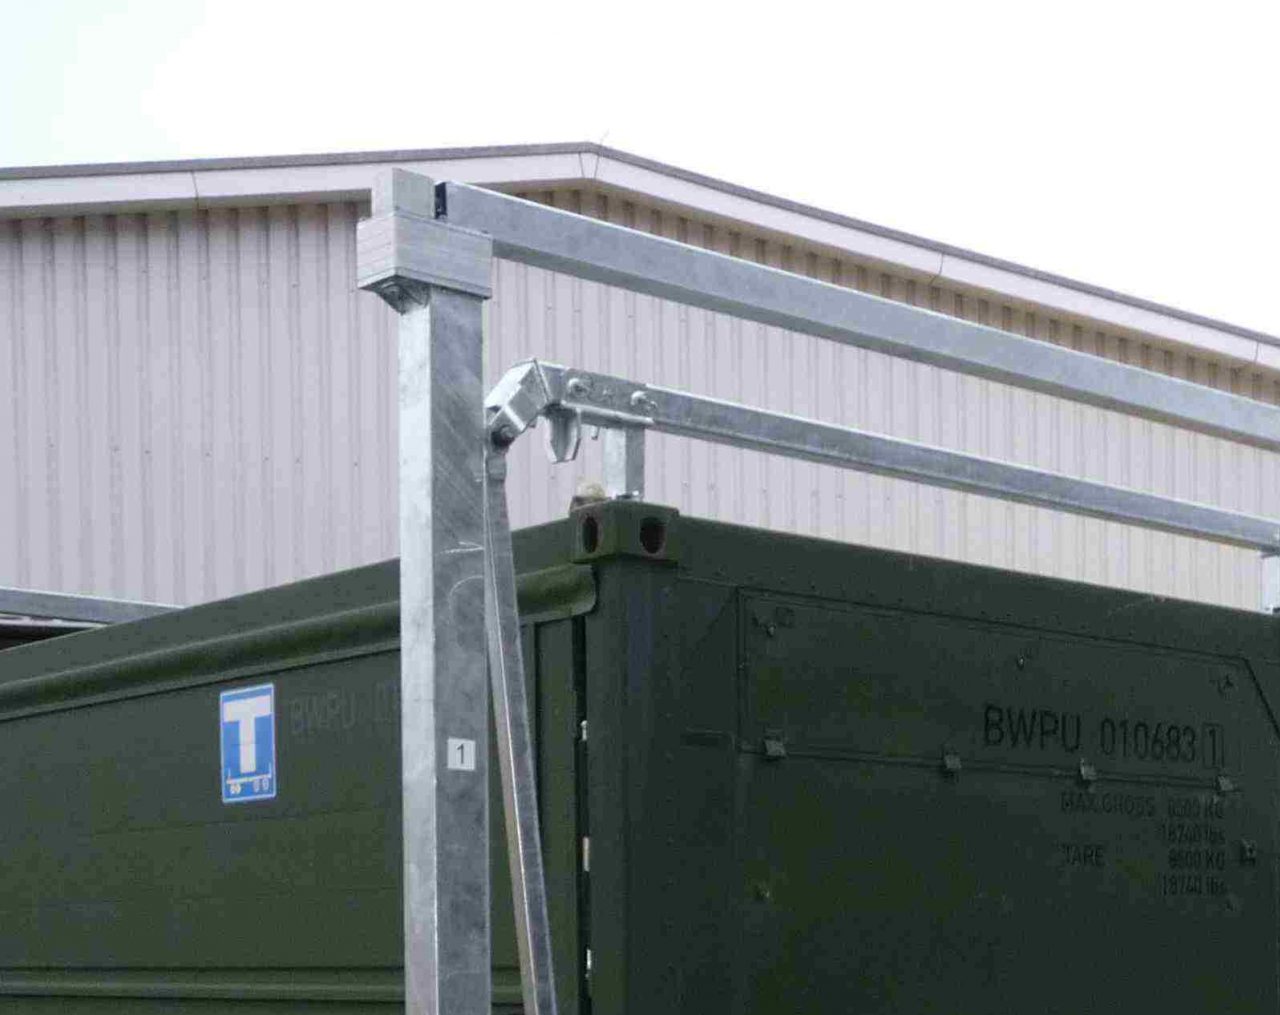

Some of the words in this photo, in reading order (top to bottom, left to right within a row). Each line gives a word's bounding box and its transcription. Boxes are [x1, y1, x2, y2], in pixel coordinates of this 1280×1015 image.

[222, 694, 272, 774] T
[456, 743, 466, 765] 1
[983, 703, 1081, 753] BWPU
[1099, 717, 1196, 763] 010683
